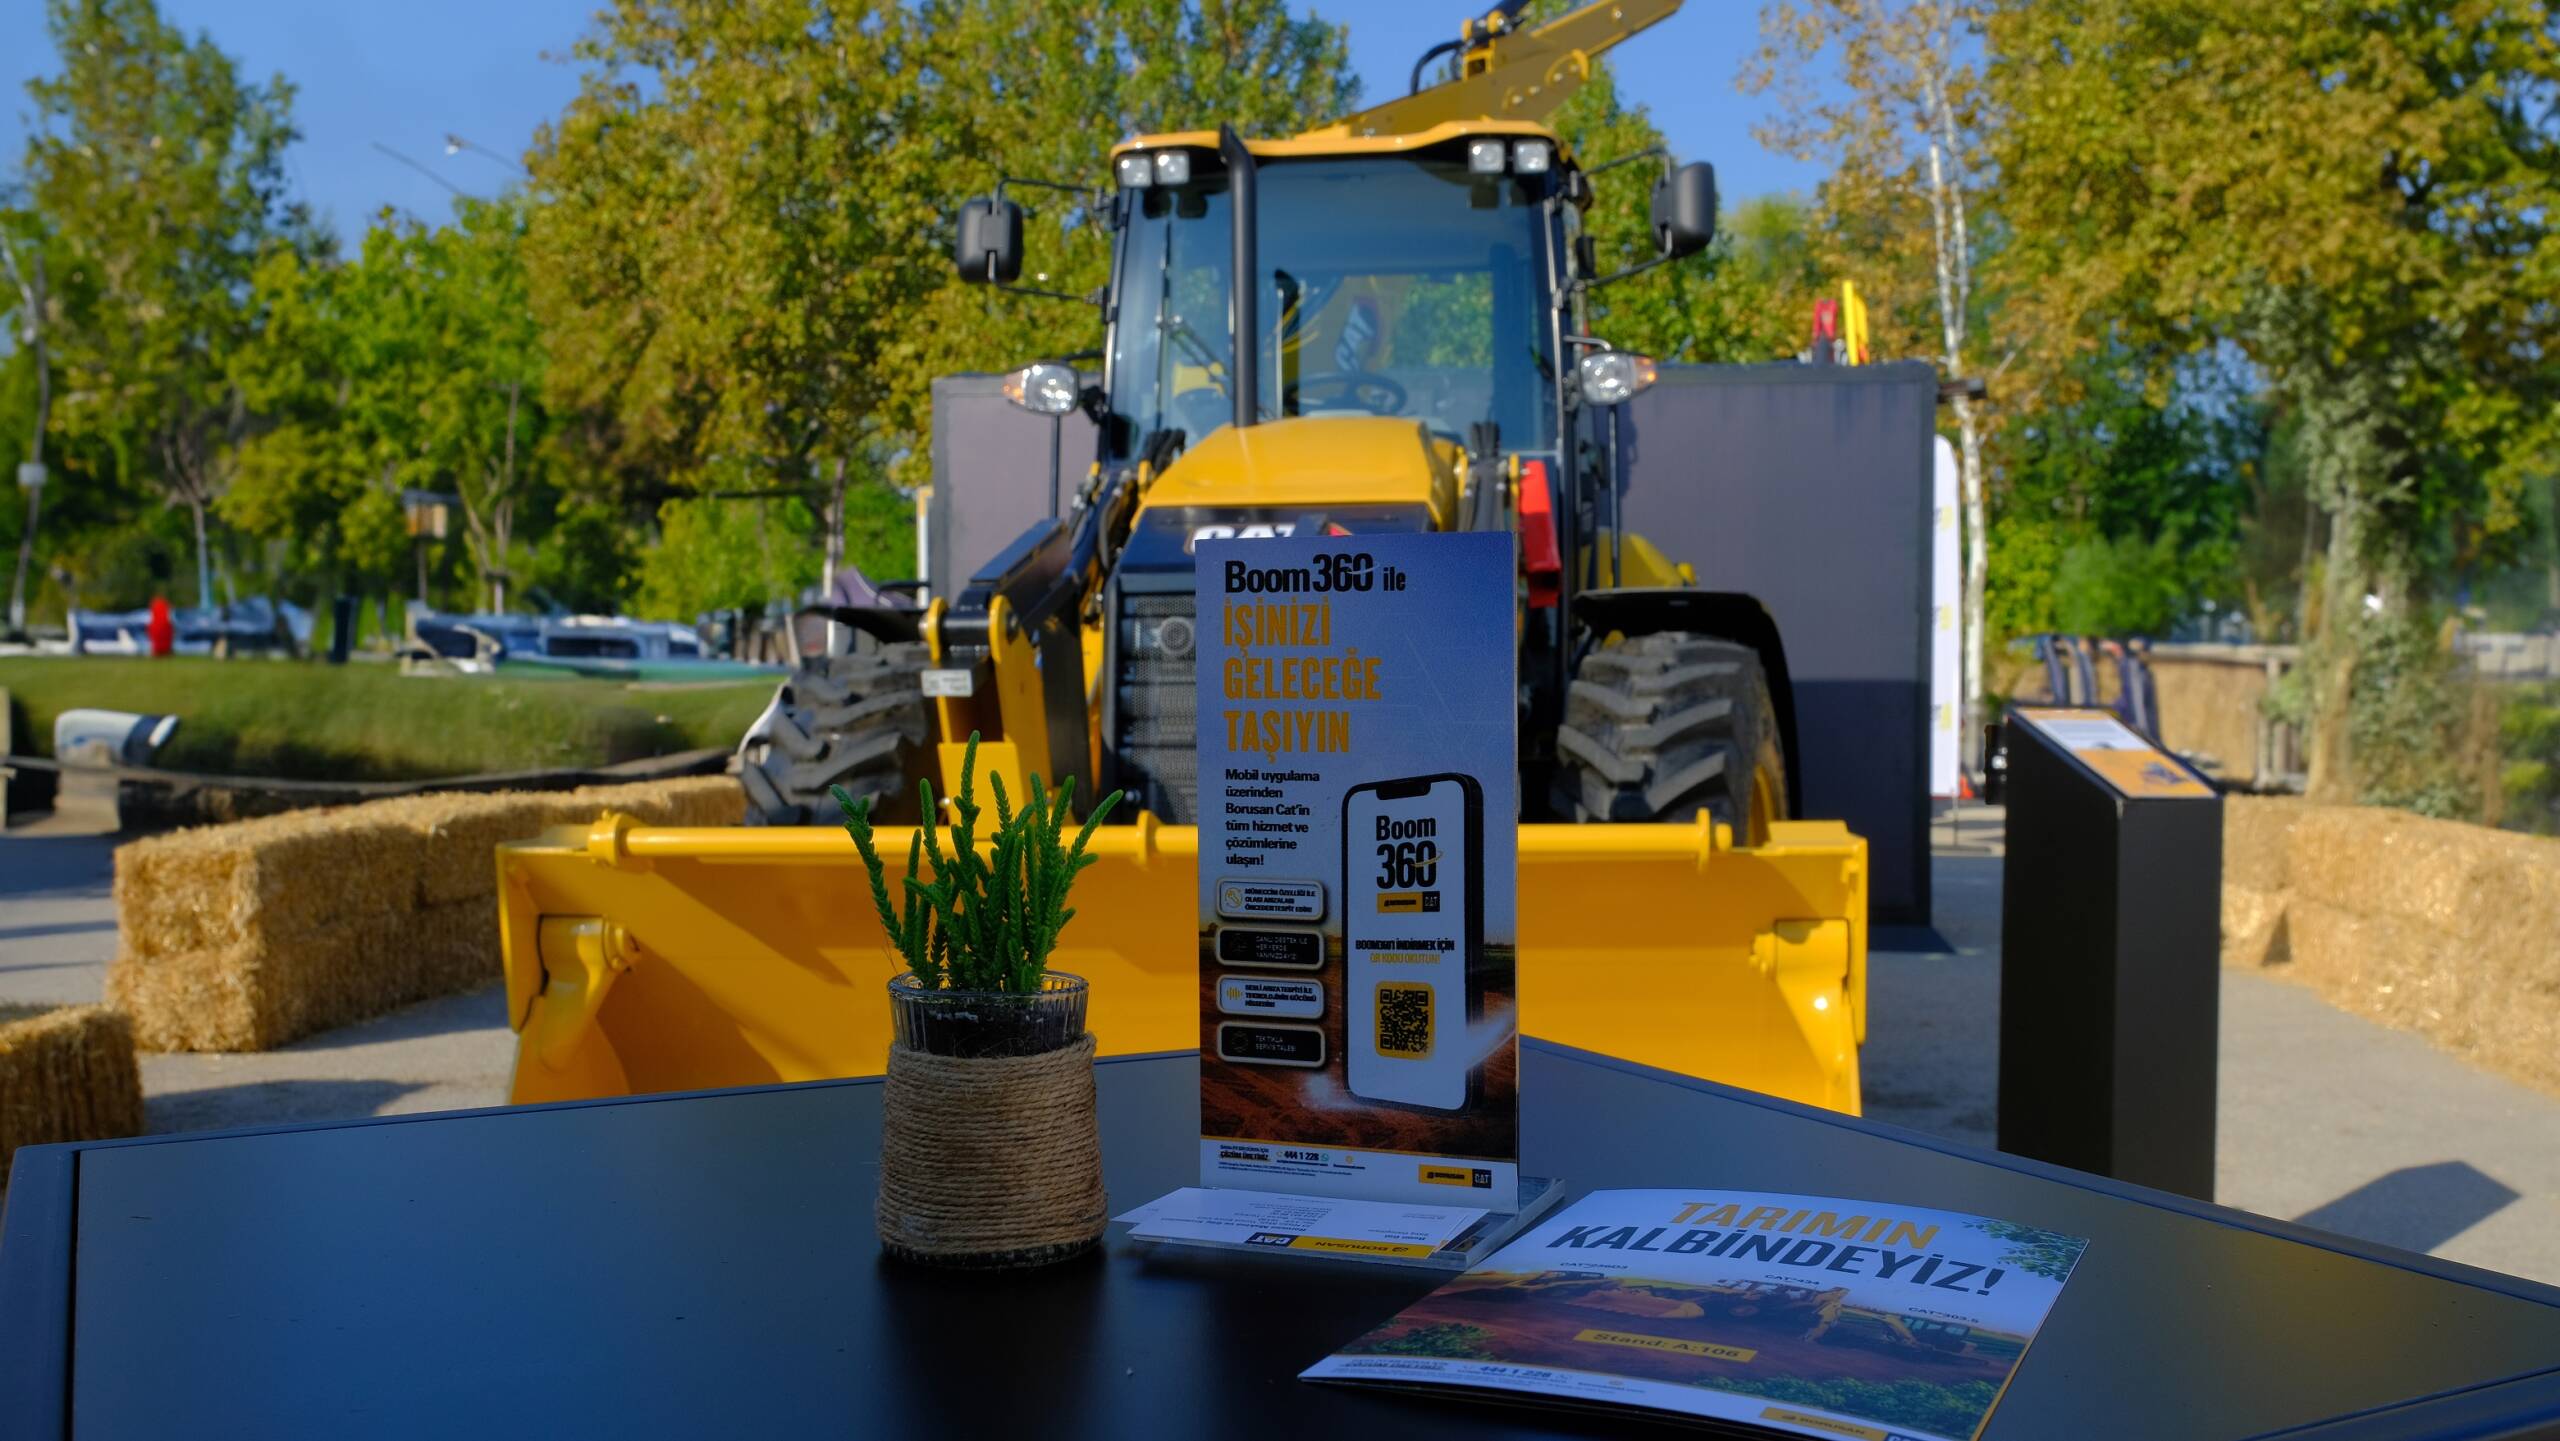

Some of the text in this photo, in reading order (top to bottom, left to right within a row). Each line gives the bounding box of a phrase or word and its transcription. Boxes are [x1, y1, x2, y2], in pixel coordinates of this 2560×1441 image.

[1225, 553, 1406, 593] Boom360 ile
[1223, 597, 1331, 656] İŞİNİZİ
[1223, 647, 1382, 699] GELECEĞE
[1223, 710, 1350, 763] TAŞIYIN
[1225, 769, 1320, 783] Mobil uygulama
[1225, 786, 1283, 798] üzerinden
[1225, 803, 1274, 814] Borusan
[1225, 820, 1309, 833] tüm hizmet ve
[1376, 815, 1437, 841] Boom
[1225, 837, 1298, 850] çözümlerine
[1226, 854, 1264, 868] ulaşın!
[1376, 840, 1437, 889] 360
[1284, 1150, 1319, 1161] 444 1 228
[1474, 1173, 1490, 1184] CAT
[1667, 1202, 1941, 1250] TARIMIN
[1250, 1234, 1292, 1245] CAT
[1546, 1225, 2006, 1296] KALBİNDEYİZ!
[1593, 1333, 1741, 1358] Stand: A:106
